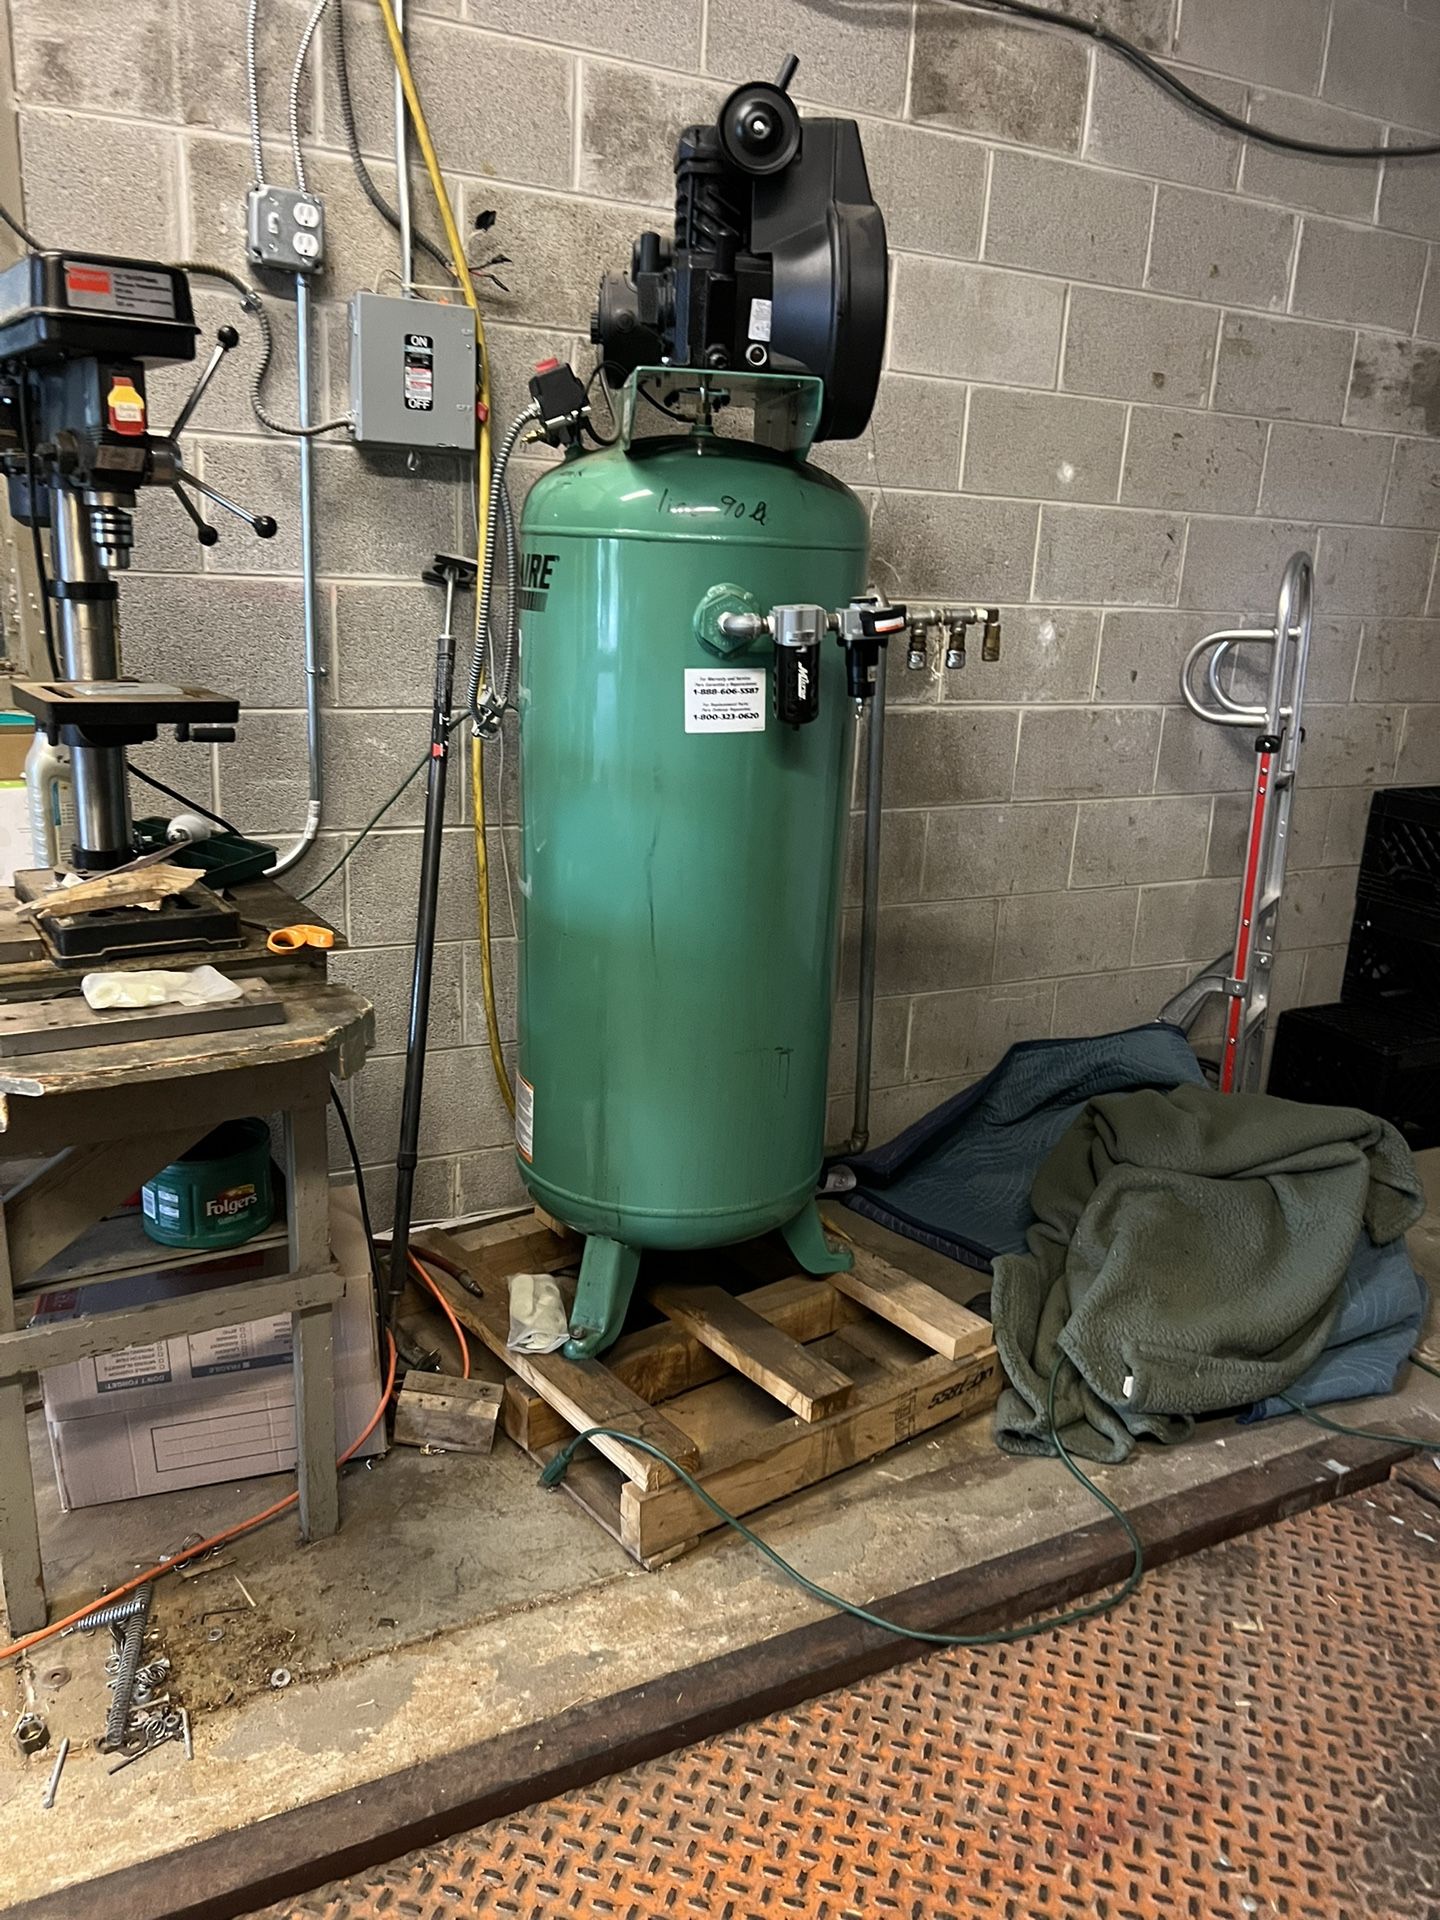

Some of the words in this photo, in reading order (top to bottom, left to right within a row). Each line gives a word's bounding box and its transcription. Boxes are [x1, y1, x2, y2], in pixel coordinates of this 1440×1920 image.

[410, 335, 428, 347] ON
[408, 398, 430, 410] OFF
[721, 495, 746, 519] 90
[206, 1193, 257, 1216] Folgers
